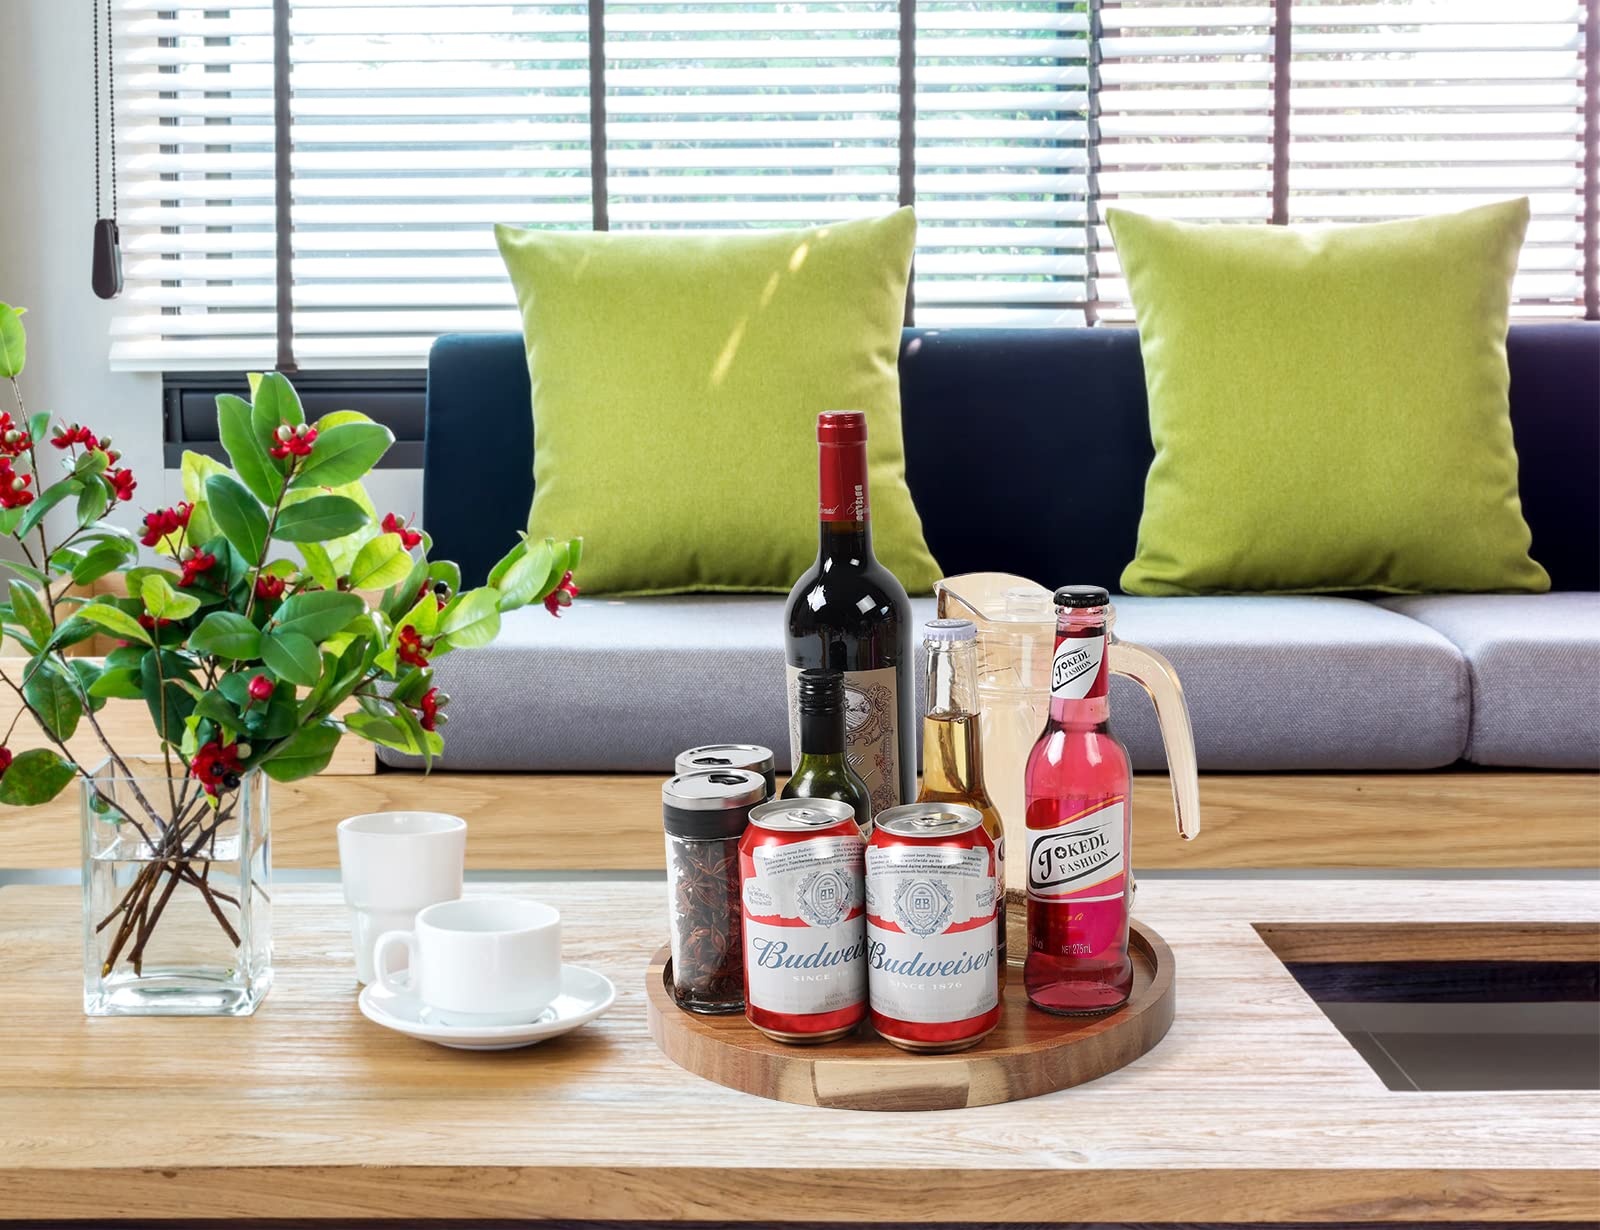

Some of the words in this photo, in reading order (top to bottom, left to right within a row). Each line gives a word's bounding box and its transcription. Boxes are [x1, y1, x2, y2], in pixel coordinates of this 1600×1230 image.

[1055, 650, 1091, 685] JOKEDL
[1064, 660, 1092, 678] FASHION
[1038, 833, 1110, 881] JOKEDL
[1059, 849, 1109, 875] FASHION
[753, 936, 867, 969] Budweis
[868, 935, 994, 977] Budweiser
[792, 974, 830, 982] SINCE
[932, 981, 963, 990] 1876
